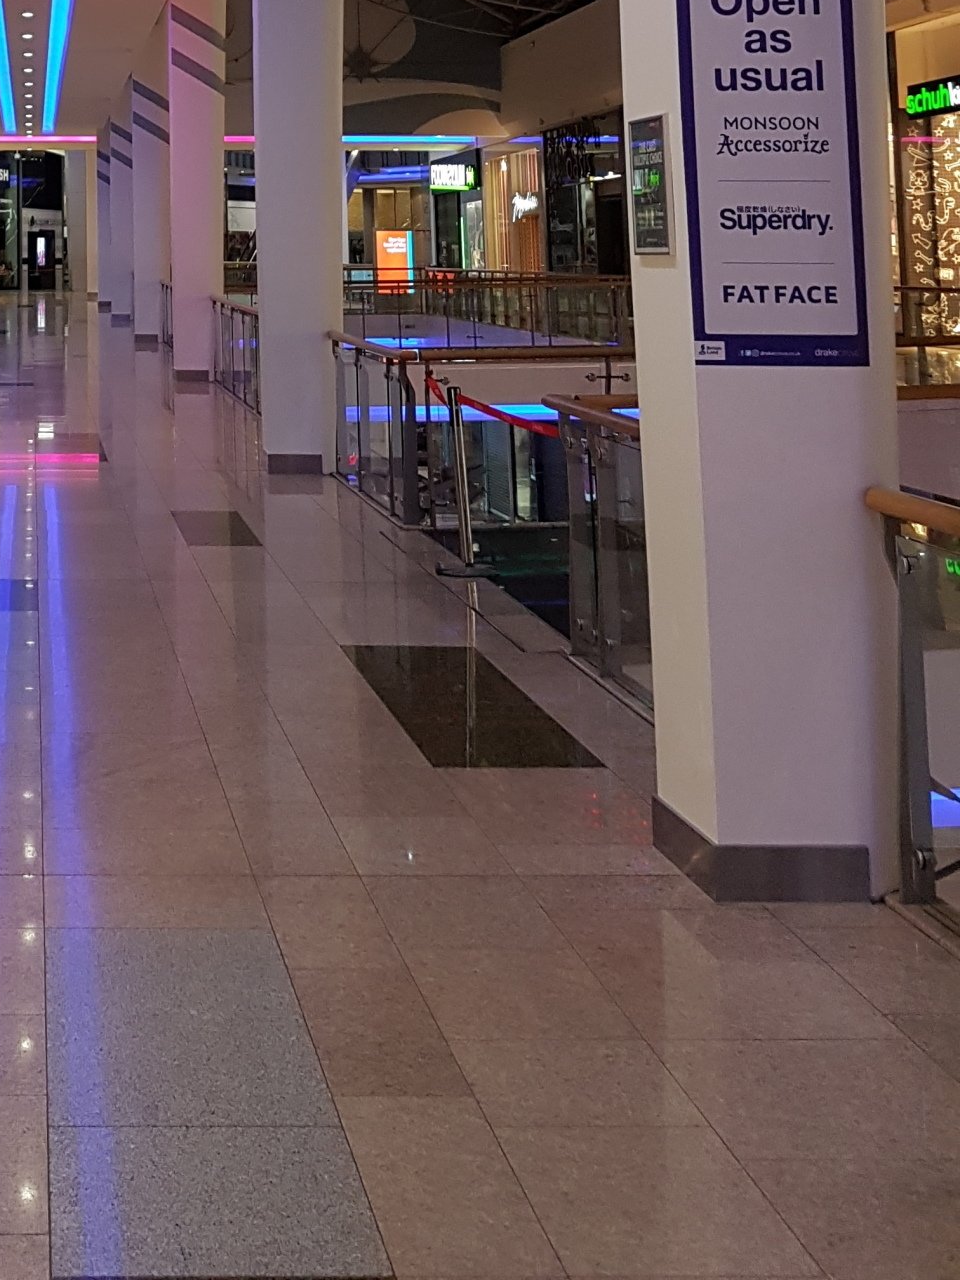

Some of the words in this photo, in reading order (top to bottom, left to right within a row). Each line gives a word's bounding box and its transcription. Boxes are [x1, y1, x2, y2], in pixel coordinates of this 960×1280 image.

[743, 29, 792, 54] as
[714, 60, 825, 93] usual
[723, 116, 820, 131] MONSOON
[716, 133, 830, 157] Accessorize
